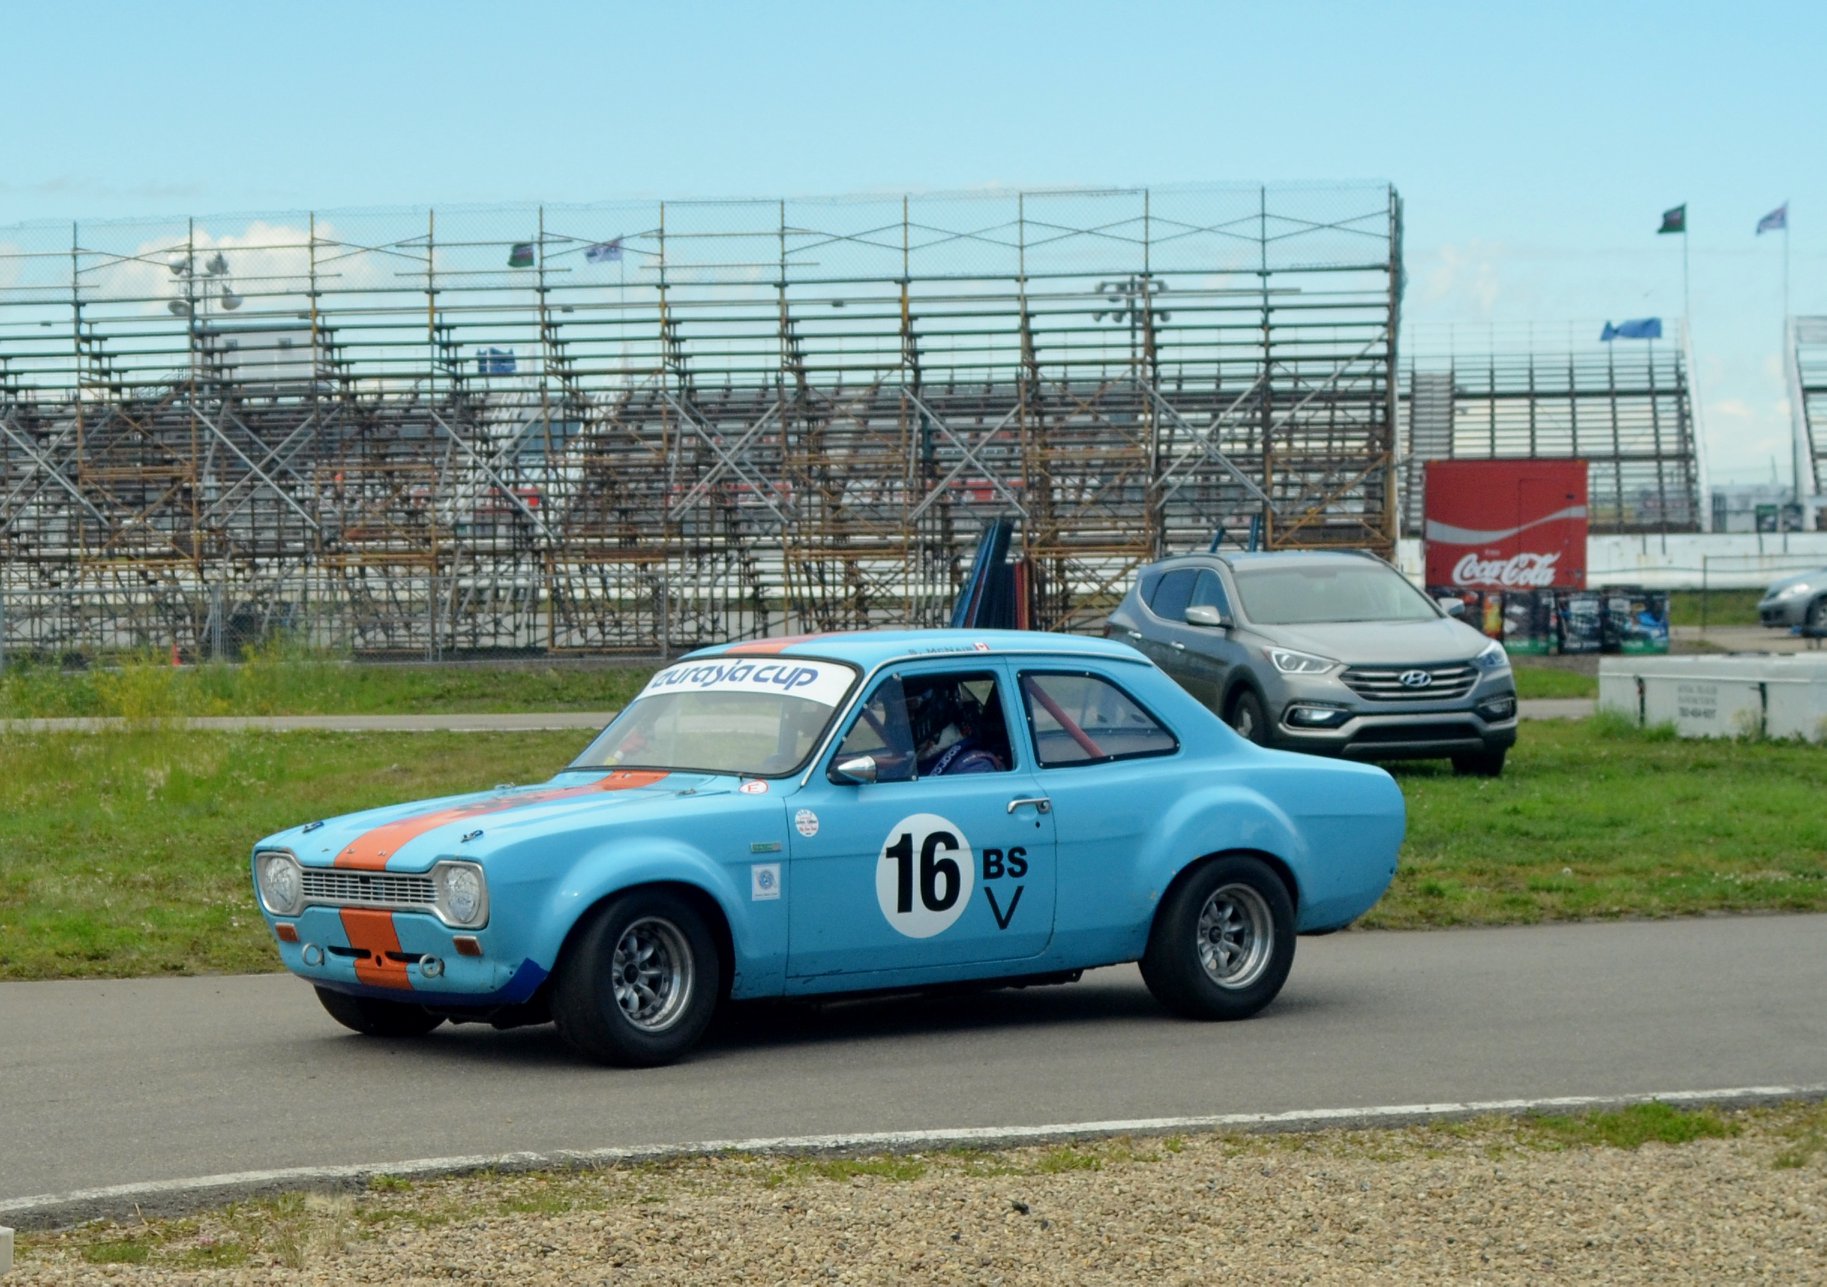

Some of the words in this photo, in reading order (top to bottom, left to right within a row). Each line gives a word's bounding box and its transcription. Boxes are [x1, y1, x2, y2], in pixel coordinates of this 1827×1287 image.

[651, 660, 756, 688] eurasia
[752, 665, 819, 690] cup
[886, 831, 961, 913] 16
[983, 846, 1029, 880] BS
[984, 885, 1025, 930] V
